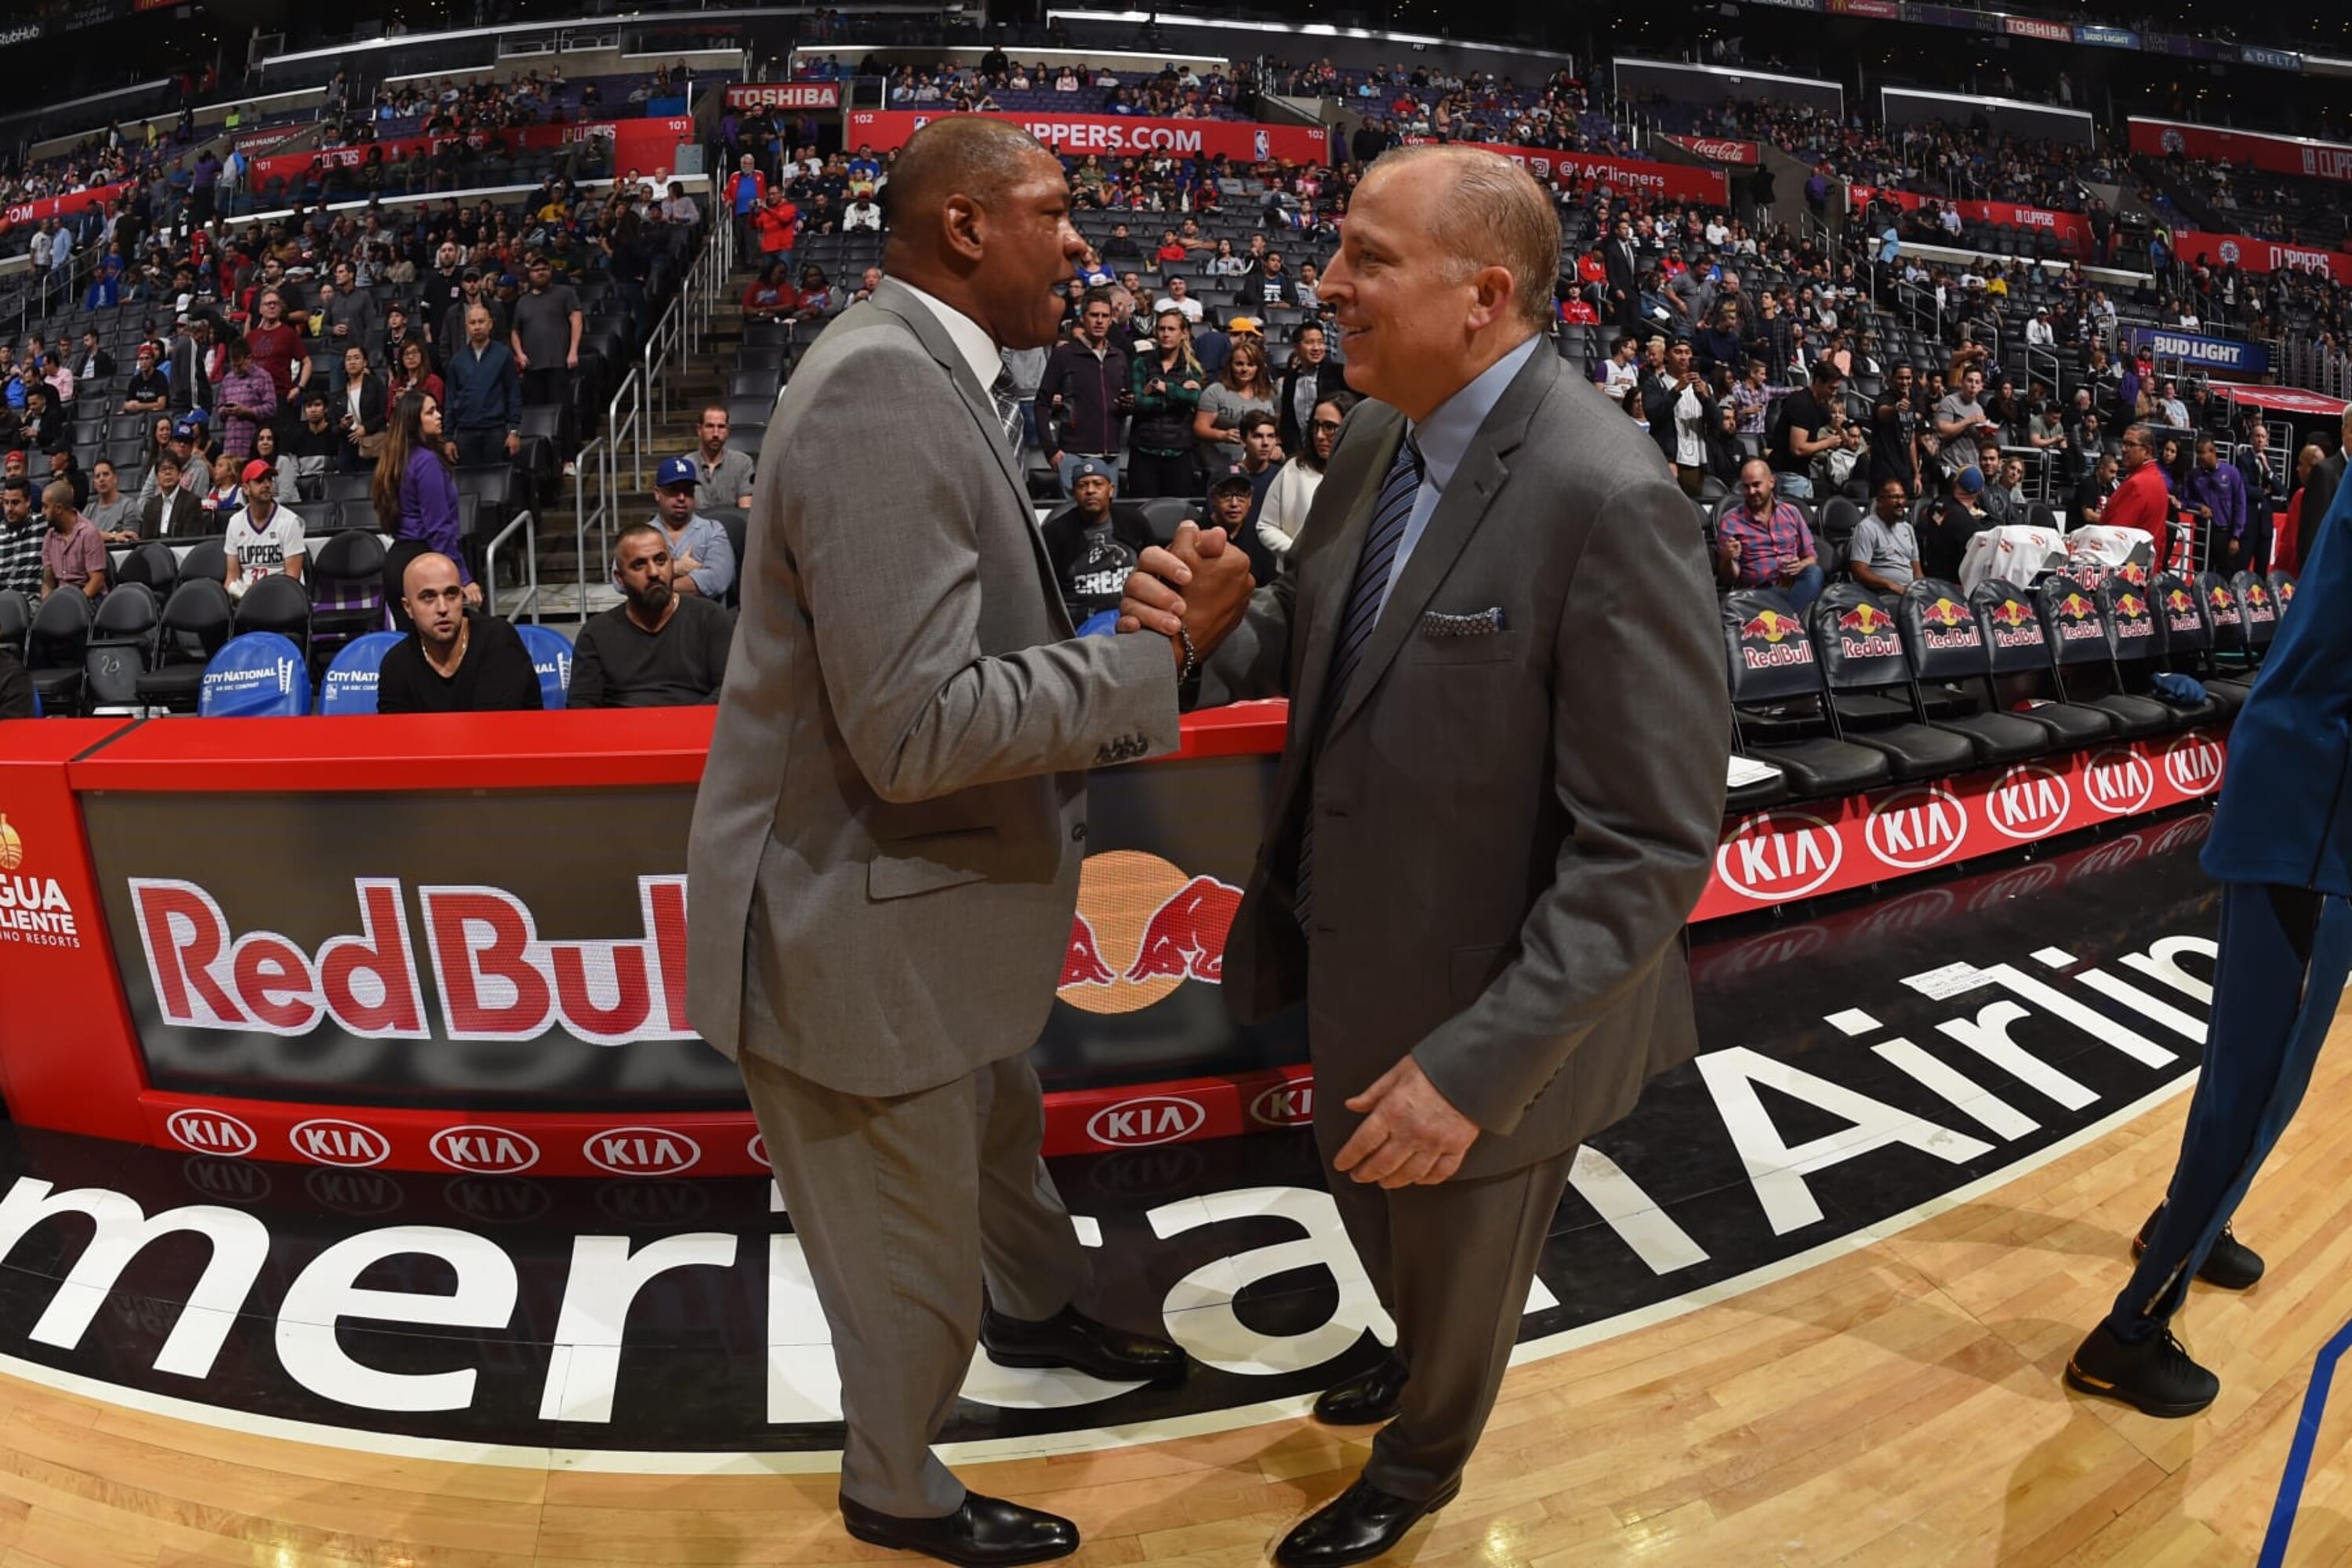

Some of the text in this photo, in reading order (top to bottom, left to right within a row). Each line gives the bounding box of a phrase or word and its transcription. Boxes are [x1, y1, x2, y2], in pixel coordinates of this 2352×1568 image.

[2006, 19, 2069, 38] TOSHIBA
[2257, 53, 2300, 70] DELTA
[730, 89, 836, 107] TOSHIBA
[669, 121, 687, 130] 101
[854, 114, 873, 124] 102
[256, 161, 270, 171] 101
[6, 205, 33, 223] OM
[2154, 336, 2240, 363] BUD LIGHT
[238, 544, 283, 564] CLIPPERS
[2178, 746, 2215, 781] KIA
[2097, 762, 2146, 800] KIA
[2001, 778, 2060, 826] KIA
[1882, 800, 1955, 855] KIA
[1738, 828, 1827, 884] KIA
[0, 931, 80, 948] NO RESORTS
[1267, 1087, 1313, 1124] KI
[178, 1116, 238, 1152] KIA
[1109, 1105, 1185, 1138] KIA
[303, 1127, 375, 1161] KIA
[445, 1132, 522, 1165] KIA
[603, 1136, 682, 1167] KIA
